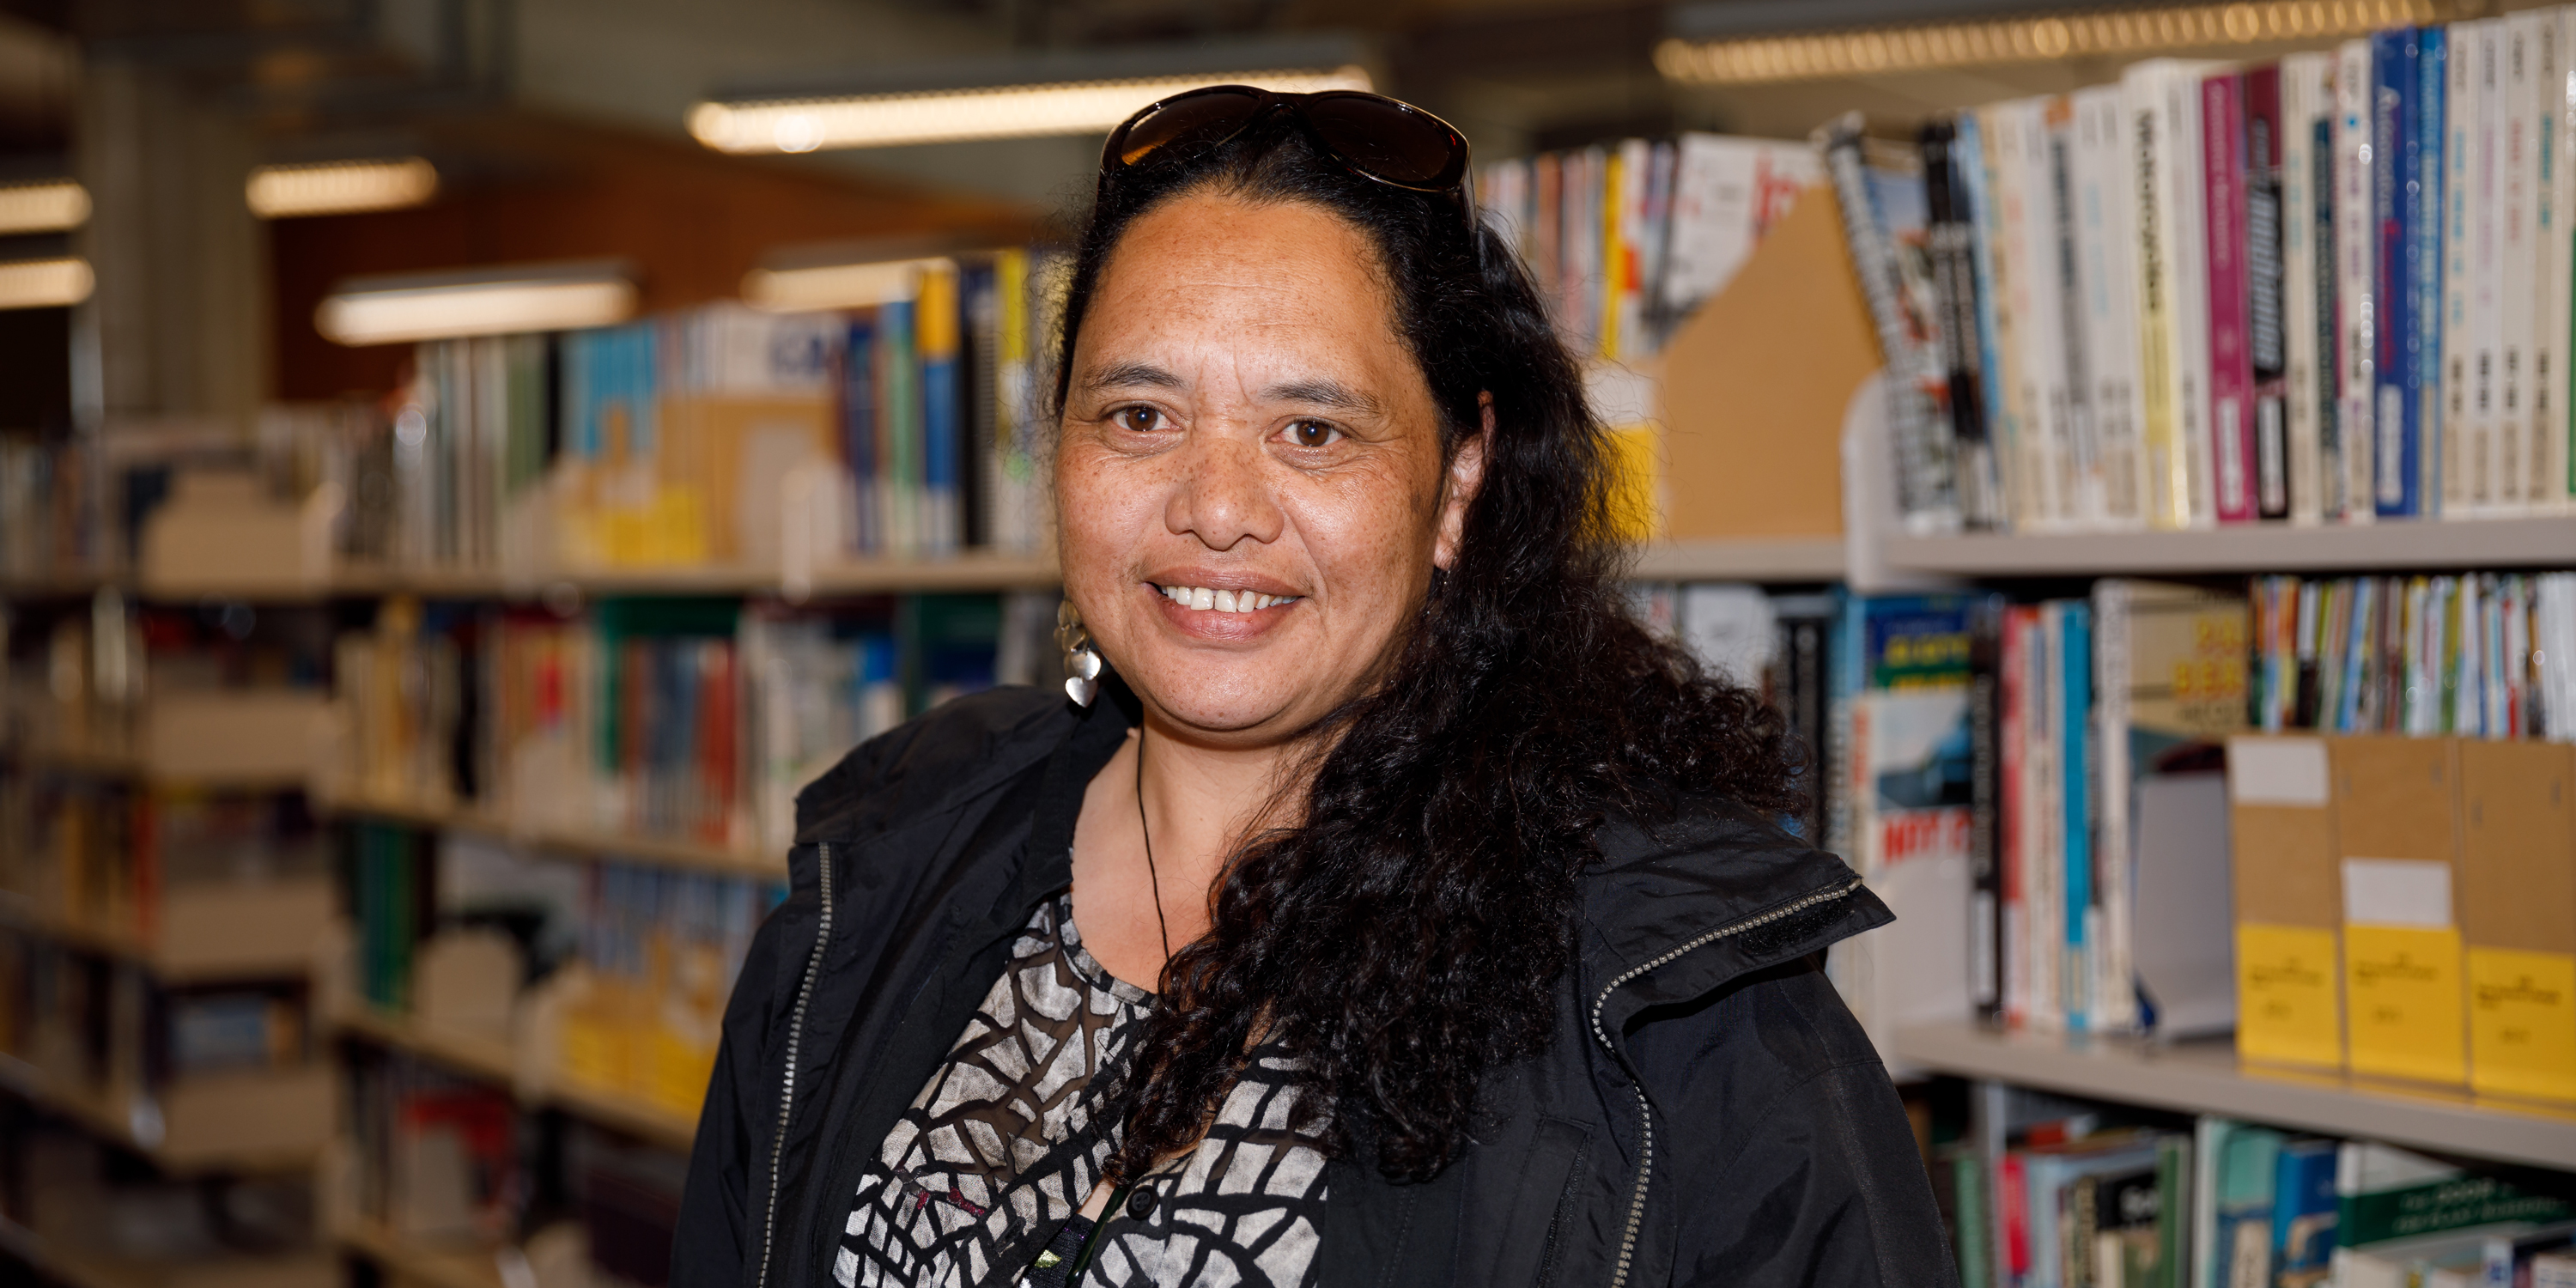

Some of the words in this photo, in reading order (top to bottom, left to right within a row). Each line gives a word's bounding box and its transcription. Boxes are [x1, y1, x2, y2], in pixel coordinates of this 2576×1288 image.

[2377, 88, 2398, 219] Automotive
[2136, 109, 2162, 314] Motorcycles
[2195, 616, 2243, 654] PA
[2172, 658, 2243, 700] BEA
[1880, 815, 1943, 866] HOT
